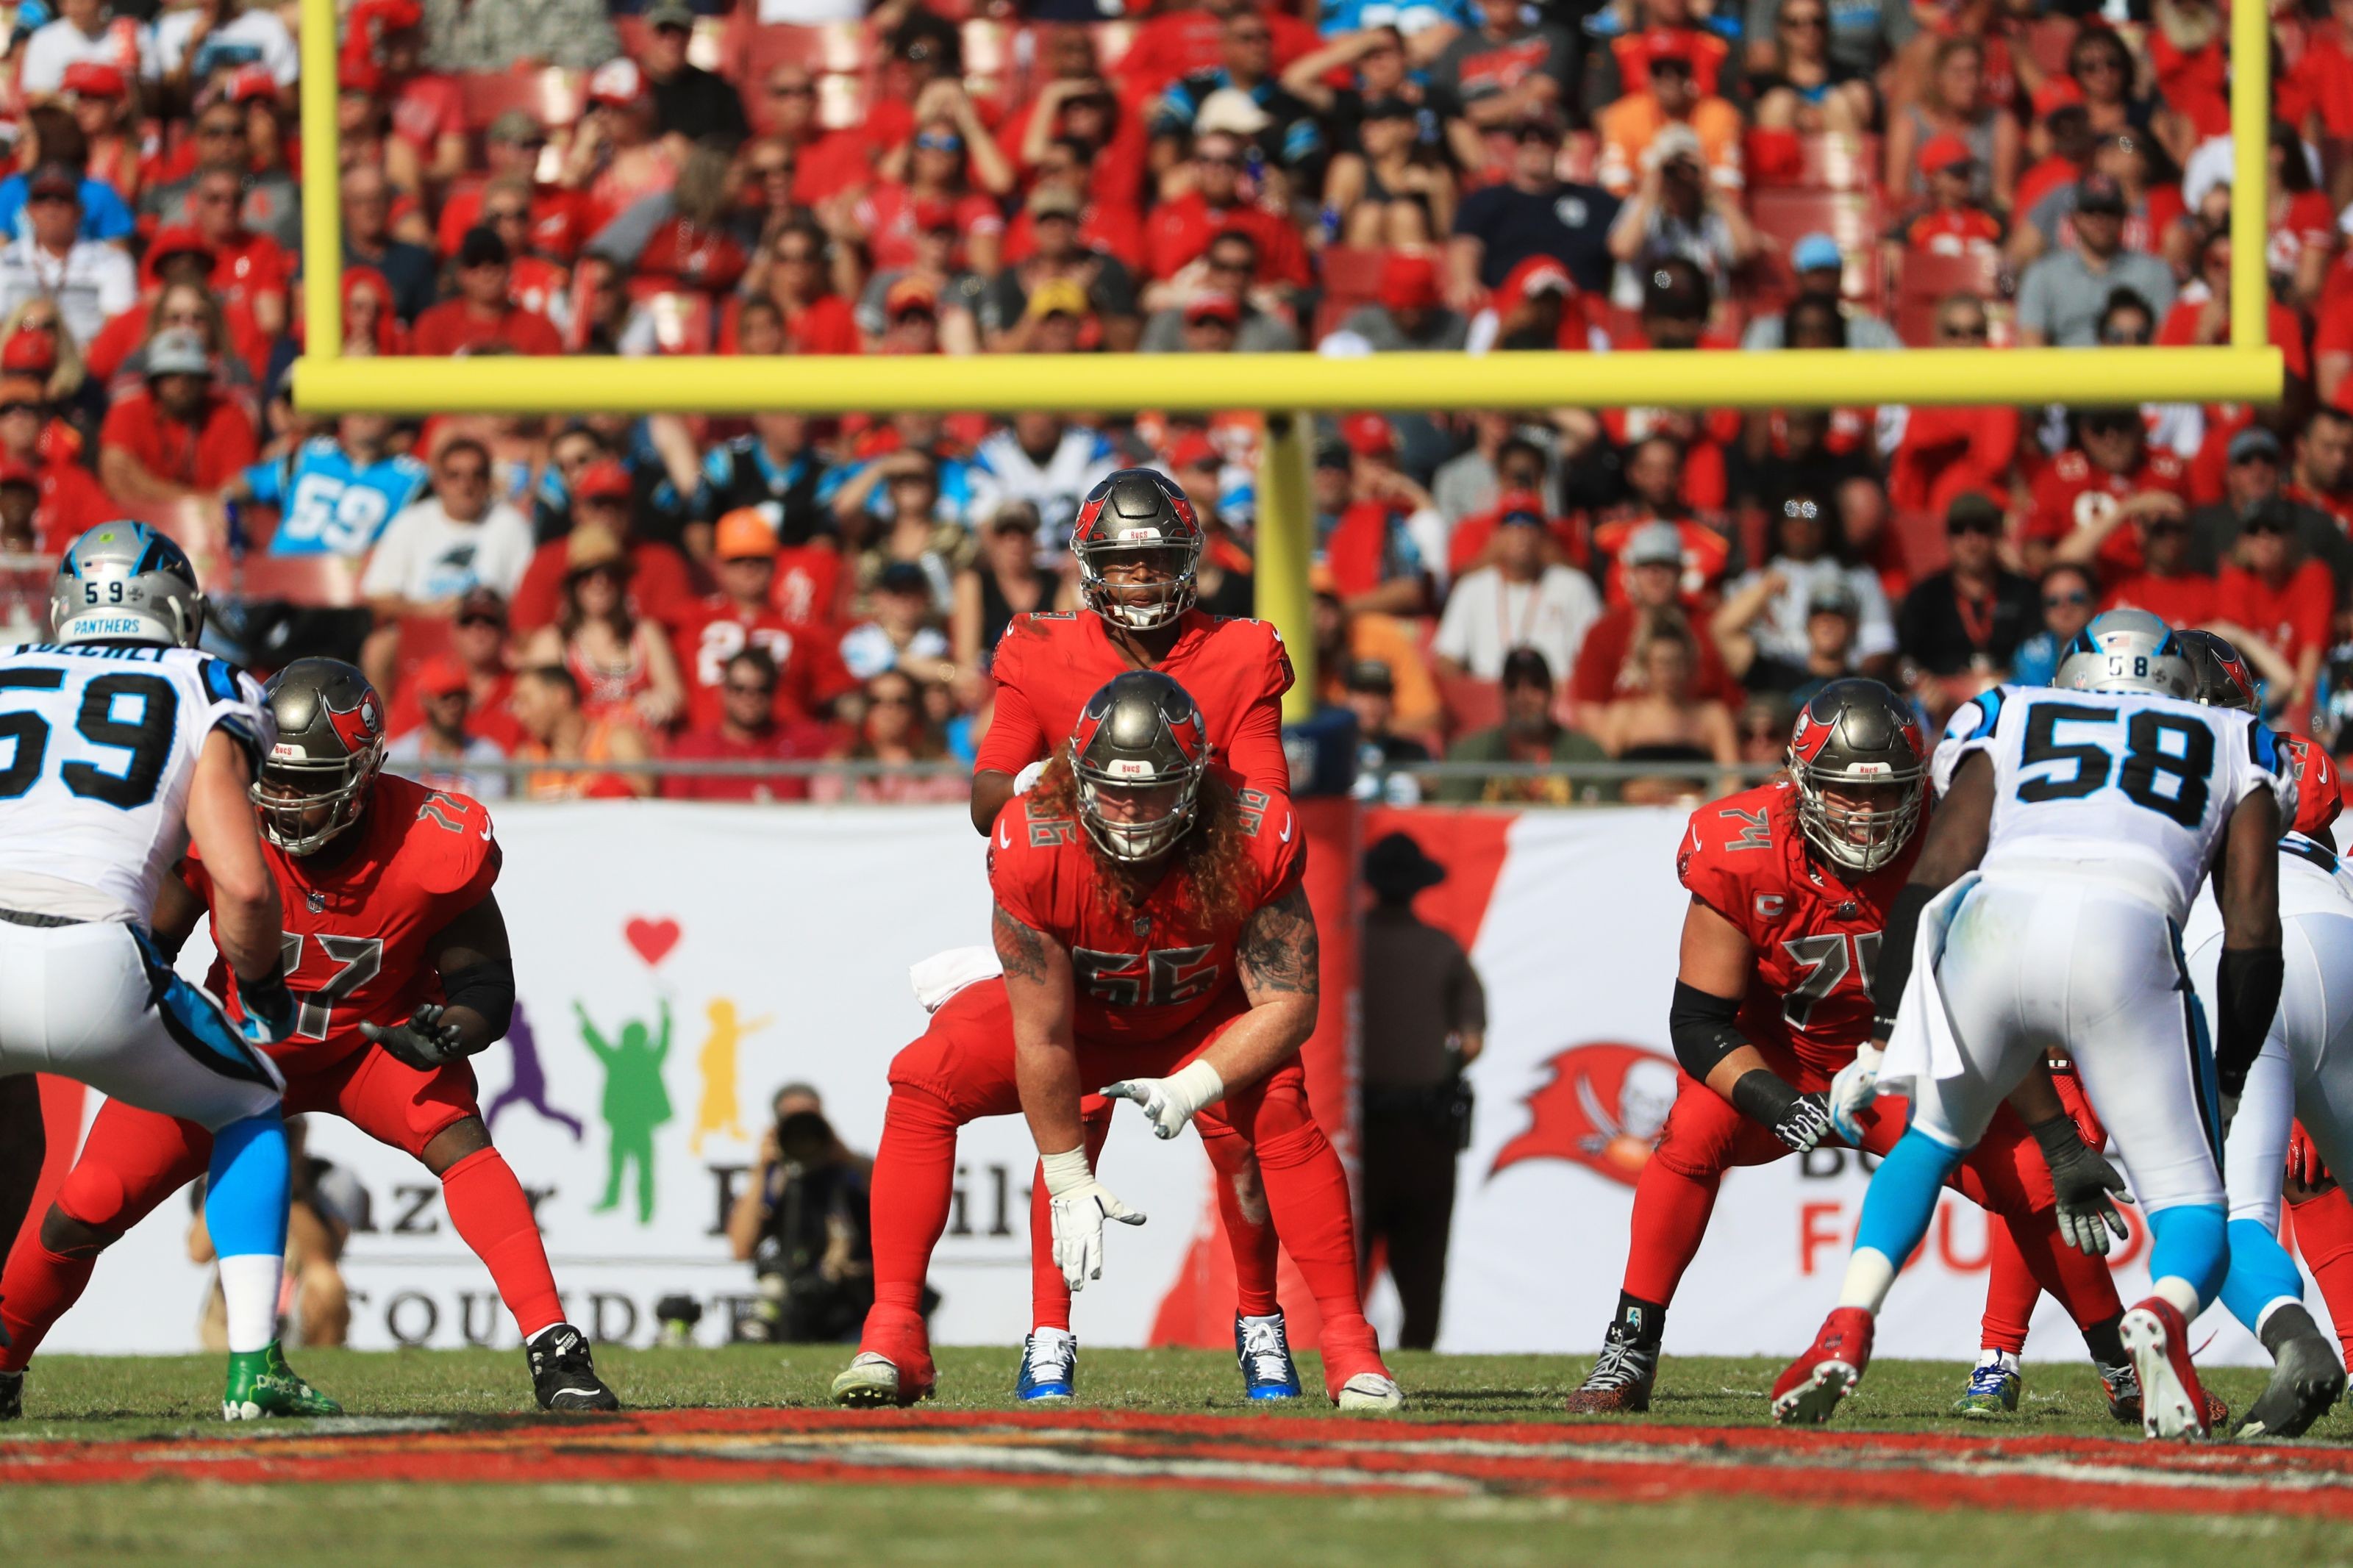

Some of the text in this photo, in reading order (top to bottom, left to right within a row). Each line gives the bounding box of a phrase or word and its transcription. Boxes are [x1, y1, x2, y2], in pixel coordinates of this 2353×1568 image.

[283, 471, 388, 556] 59
[85, 581, 123, 604] 59
[74, 619, 140, 635] PANTHERS
[2109, 656, 2149, 677] 58
[0, 666, 180, 812] 59
[2016, 701, 2216, 830] 58
[1718, 806, 1773, 852] 74
[1756, 894, 1785, 917] C
